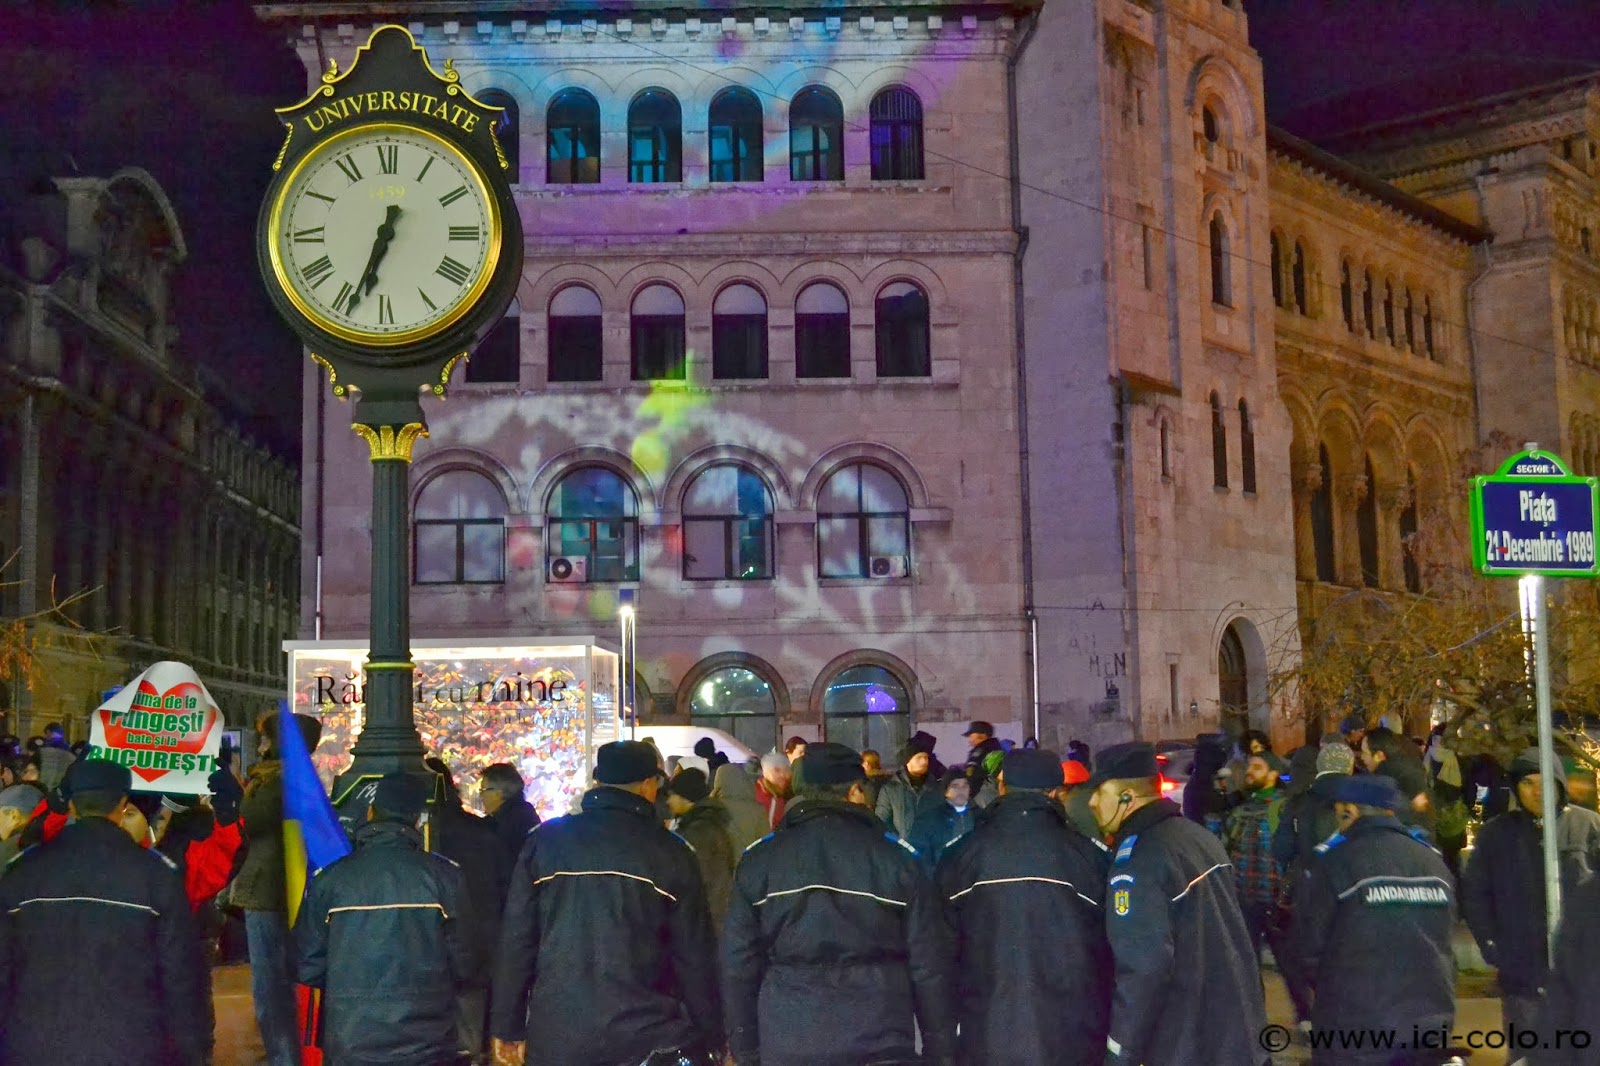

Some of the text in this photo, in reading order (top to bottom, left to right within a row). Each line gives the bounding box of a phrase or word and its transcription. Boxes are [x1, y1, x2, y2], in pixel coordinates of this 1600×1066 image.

[303, 90, 480, 133] UNIVERSITATE
[369, 184, 406, 199] 1459
[1516, 465, 1556, 473] SECTOR 1
[1486, 530, 1594, 562] 21 Decembrie 1989
[314, 672, 424, 704] Răi
[435, 686, 464, 703] cu
[472, 671, 567, 702] mine
[164, 695, 183, 709] de
[185, 695, 197, 709] la
[127, 733, 152, 744] bate
[166, 736, 178, 746] la
[1366, 886, 1448, 902] JANDARMERIA
